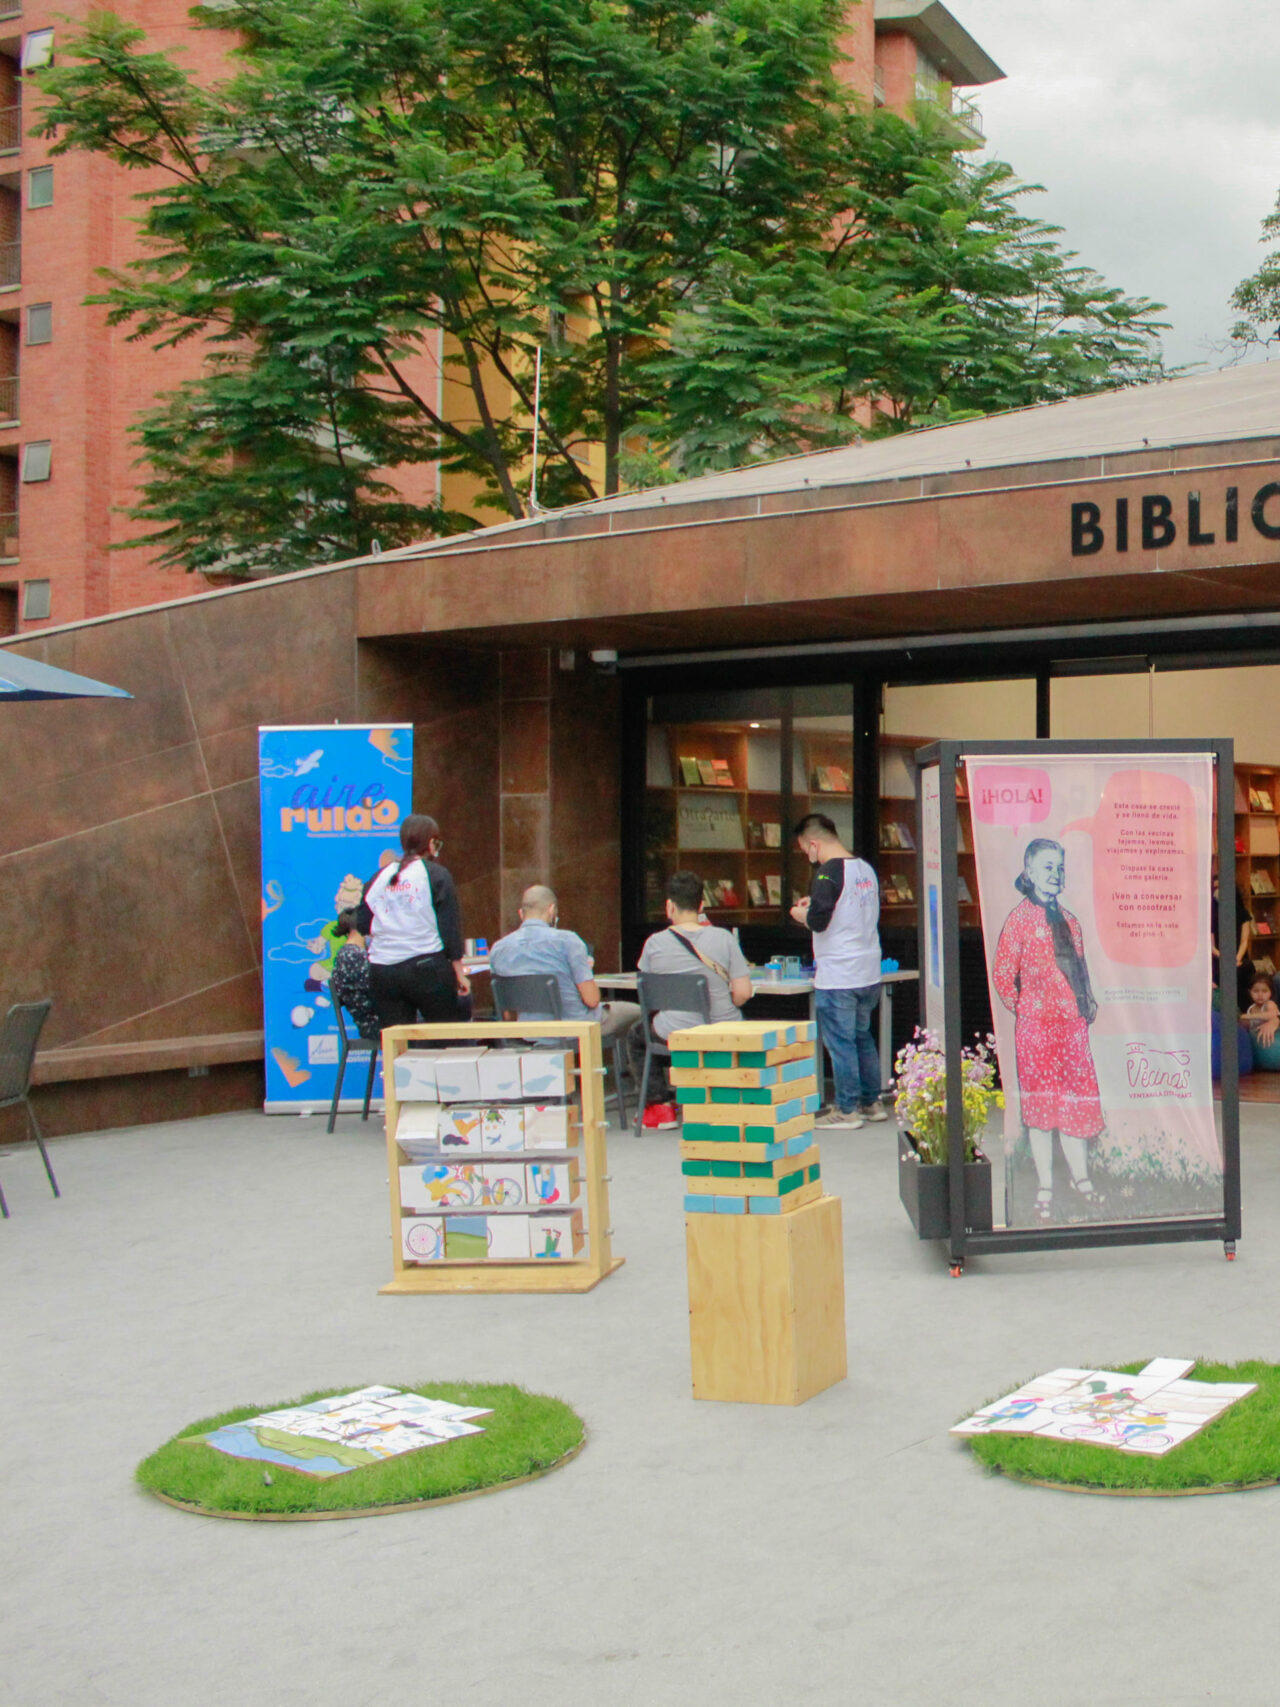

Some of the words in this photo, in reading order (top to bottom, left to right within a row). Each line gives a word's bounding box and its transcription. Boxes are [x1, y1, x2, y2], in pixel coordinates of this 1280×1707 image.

[291, 776, 387, 810] aire
[982, 788, 1043, 804] ¡HOLA!
[1112, 892, 1131, 901] ¡Ven
[1137, 904, 1176, 912] nosotras!
[1126, 1057, 1191, 1089] Vecinas
